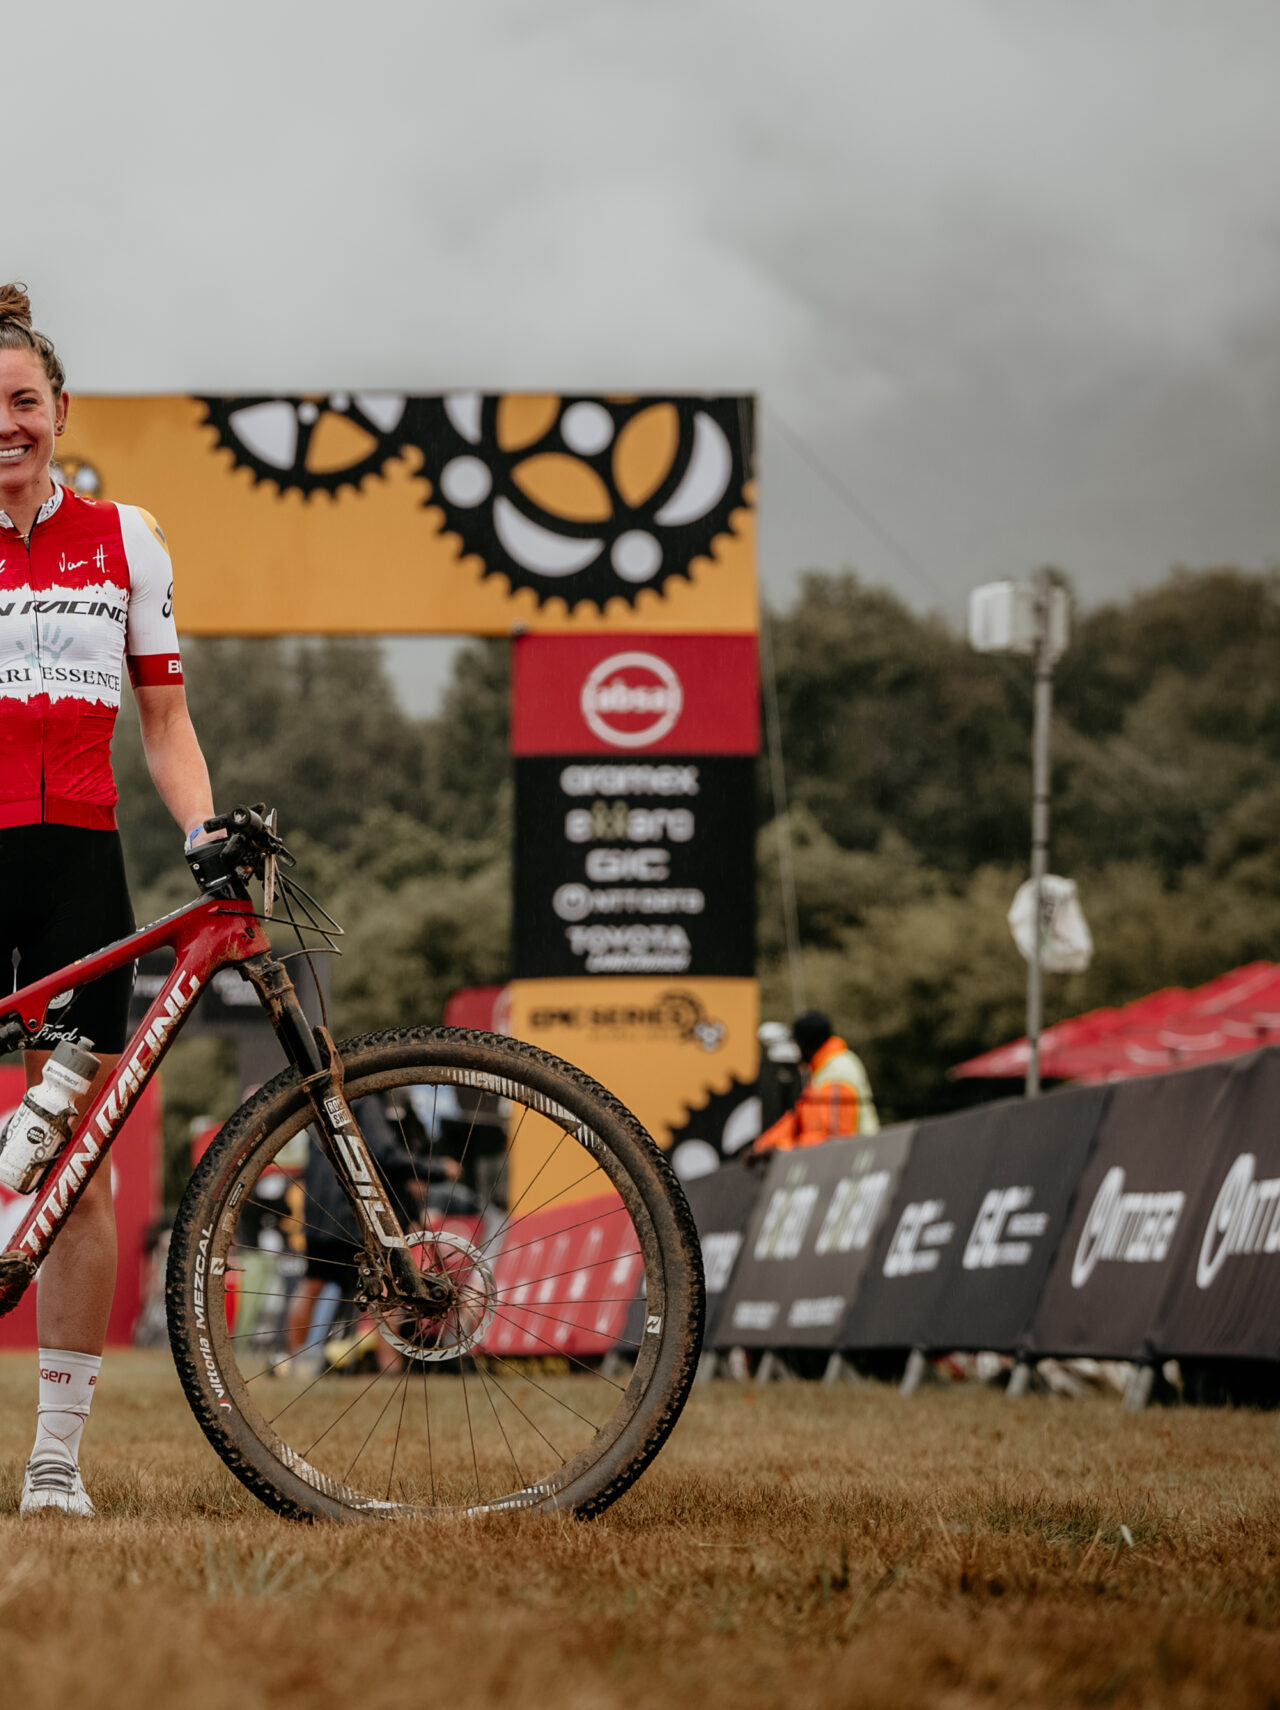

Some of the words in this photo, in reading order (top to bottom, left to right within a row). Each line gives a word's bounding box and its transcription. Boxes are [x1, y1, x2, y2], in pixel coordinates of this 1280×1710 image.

[42, 667, 121, 692] ESSENCE
[565, 925, 691, 955] TOYOTA
[20, 1131, 100, 1253] TITAN
[193, 1223, 214, 1329] MEZCAL
